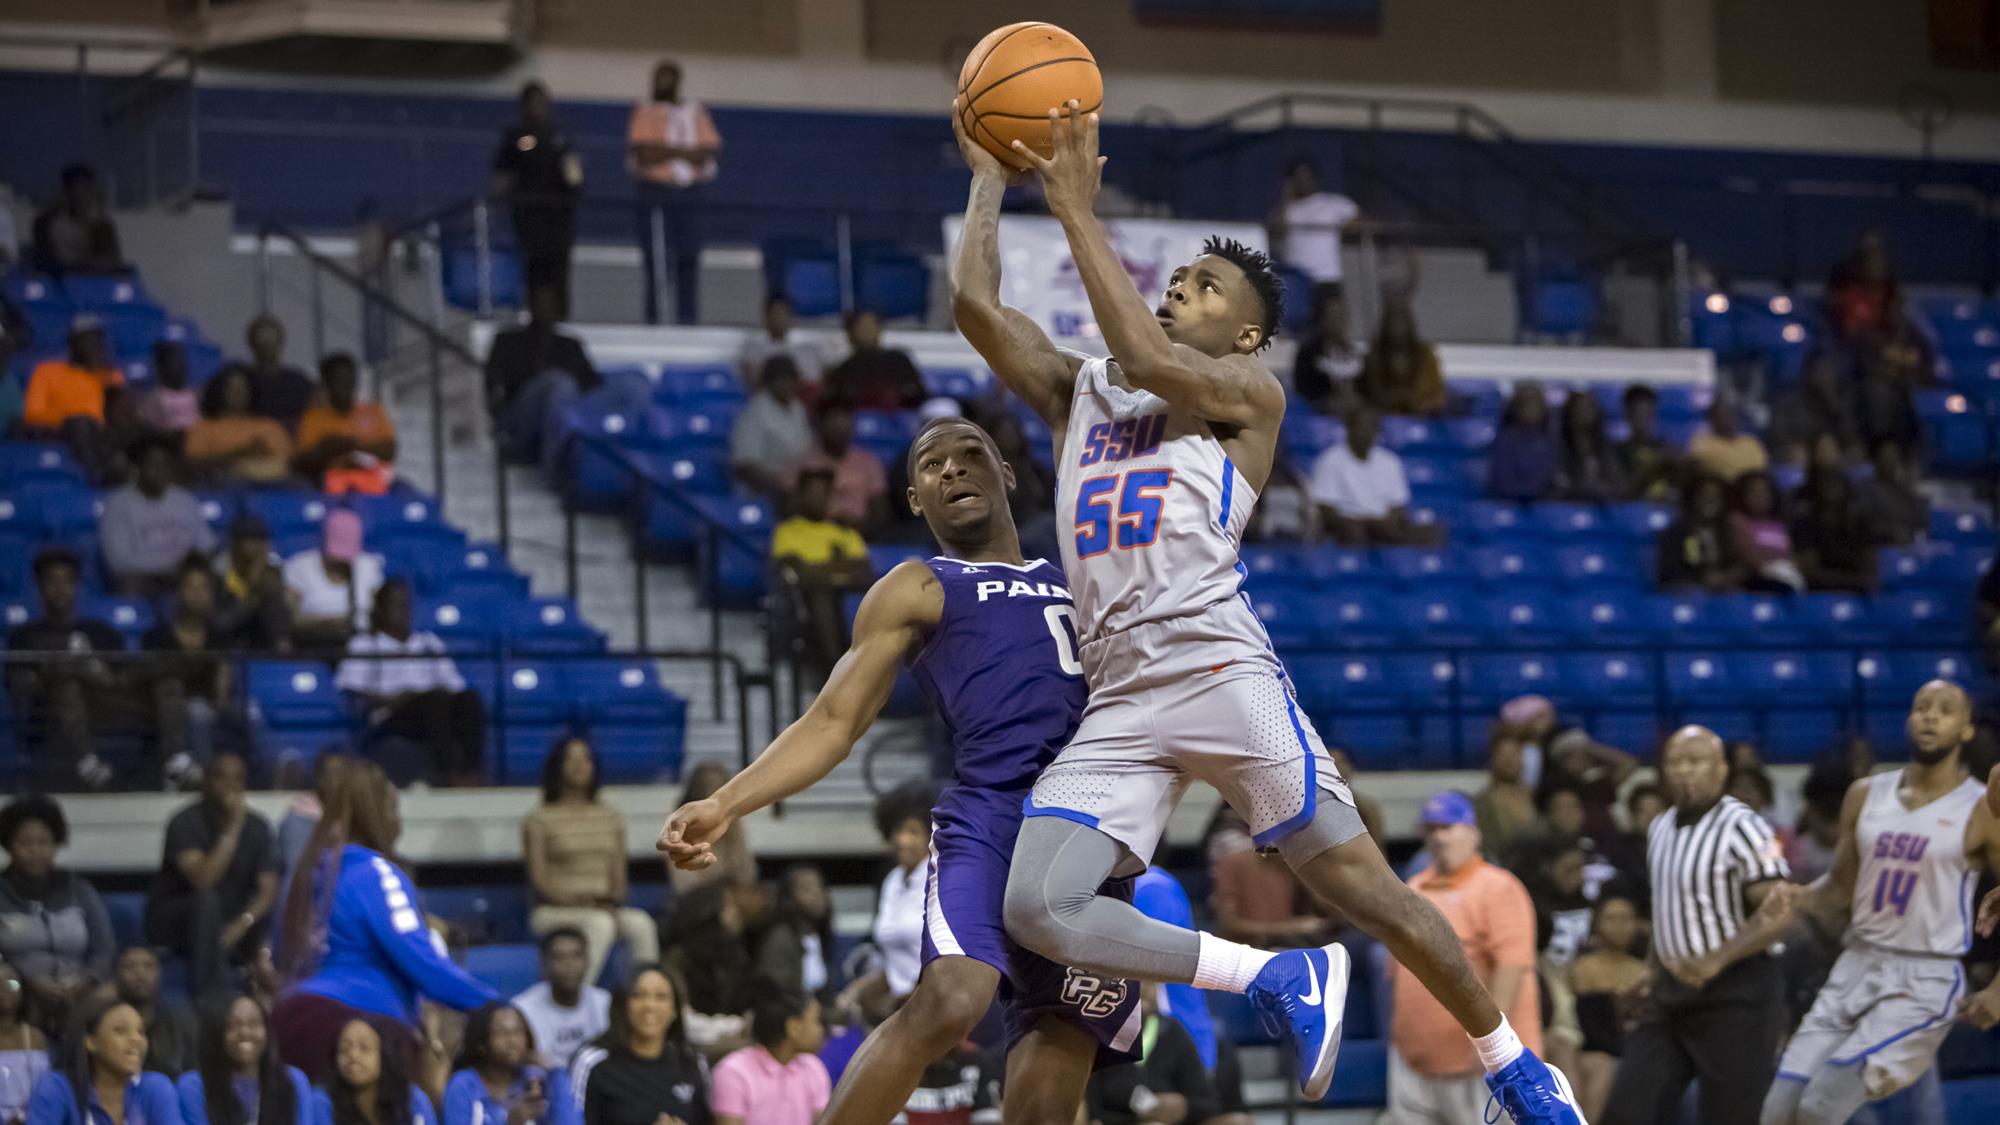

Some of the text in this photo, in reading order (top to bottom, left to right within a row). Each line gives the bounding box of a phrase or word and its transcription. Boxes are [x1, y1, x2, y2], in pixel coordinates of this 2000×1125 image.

[1080, 413, 1168, 468] SSU
[1074, 468, 1173, 560] 55
[977, 580, 1073, 602] PAIN
[1043, 604, 1084, 675] 0
[1873, 831, 1930, 862] SSU
[1872, 867, 1918, 917] 14
[1062, 974, 1123, 1016] PC
